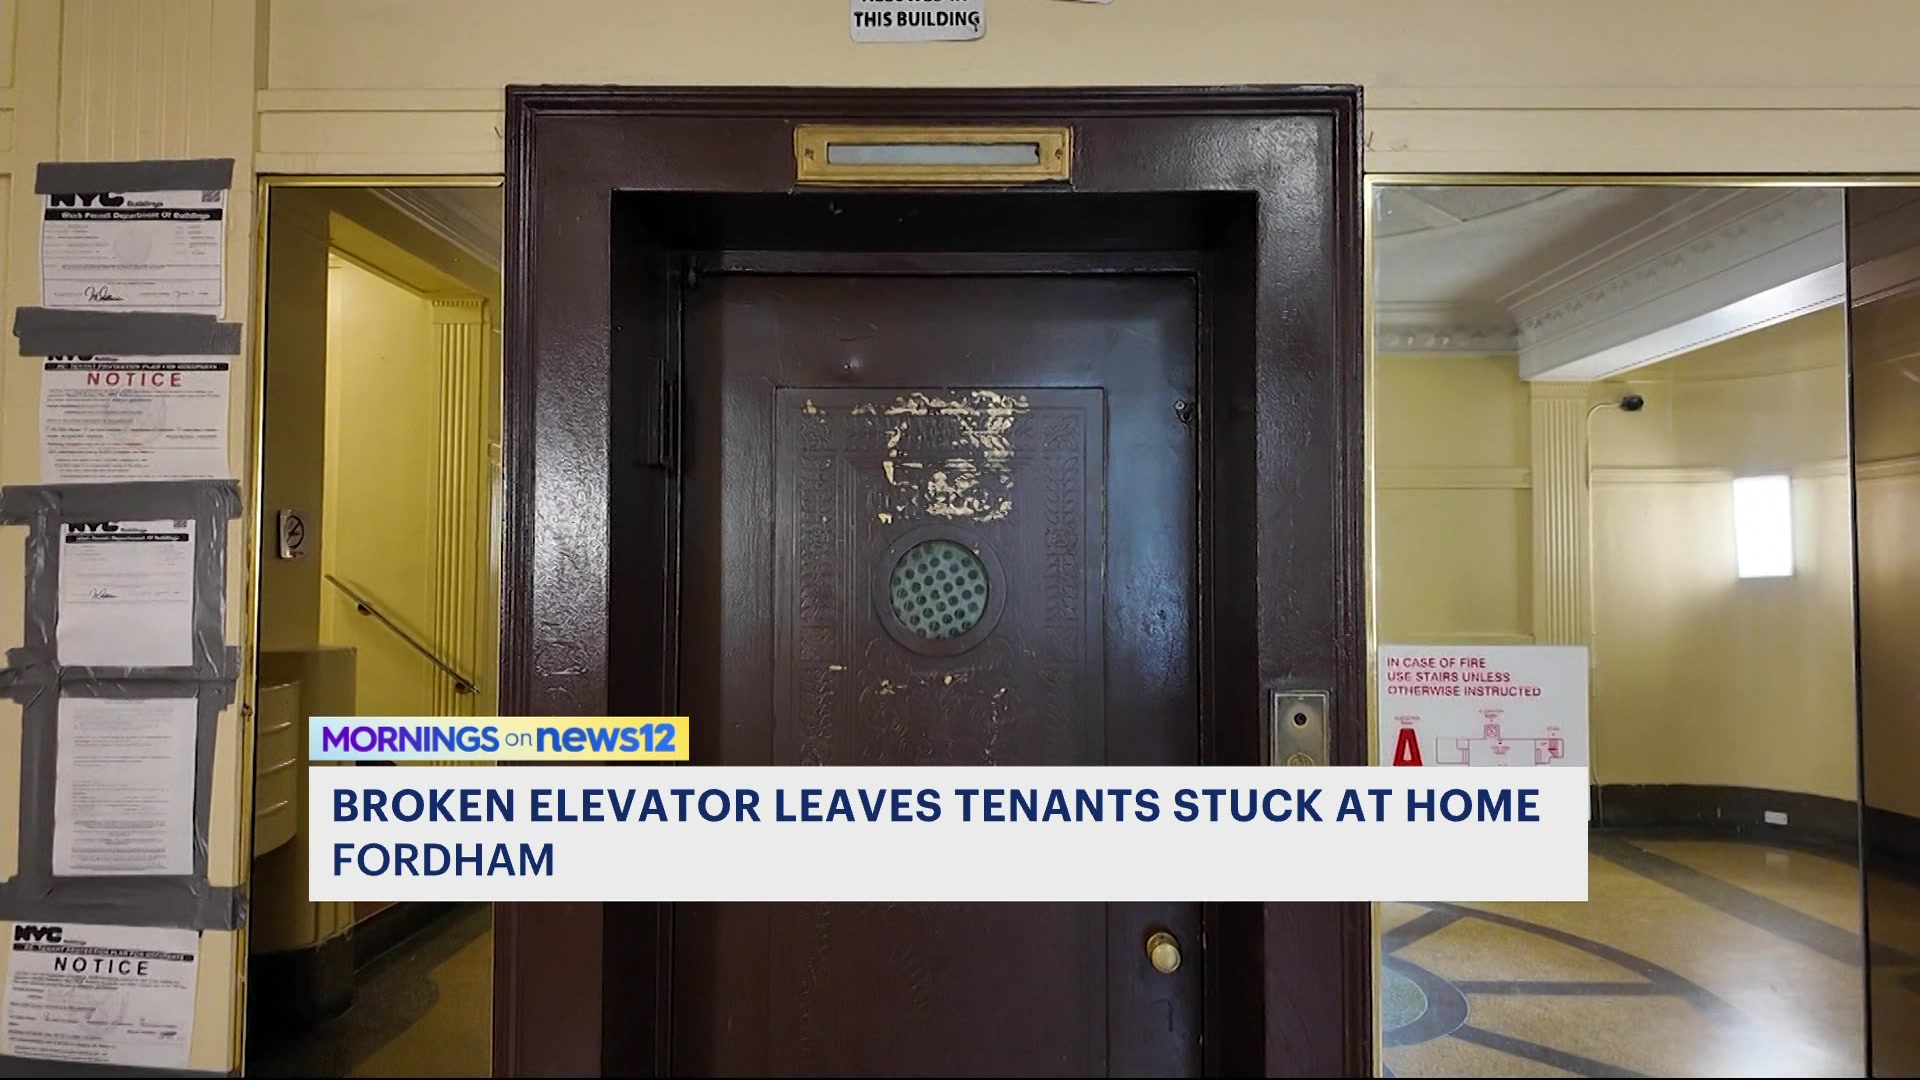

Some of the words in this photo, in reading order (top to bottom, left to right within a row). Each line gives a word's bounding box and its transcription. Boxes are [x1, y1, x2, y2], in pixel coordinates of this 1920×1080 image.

[853, 11, 892, 27] THIS
[897, 11, 980, 29] BUILDING
[87, 372, 182, 387] NOTICE
[1387, 658, 1399, 668] IN
[1403, 658, 1436, 668] CASE
[1439, 658, 1456, 668] OF
[1460, 658, 1487, 668] FIRE
[1387, 672, 1411, 682] USE
[1416, 672, 1459, 682] STAIRS
[1462, 672, 1511, 682] UNLESS
[1388, 686, 1460, 697] OTHERWISE
[1464, 686, 1542, 697] INSTRUCTED
[1392, 728, 1423, 766] A
[14, 925, 63, 942] NYC
[54, 957, 149, 976] NOTICE
